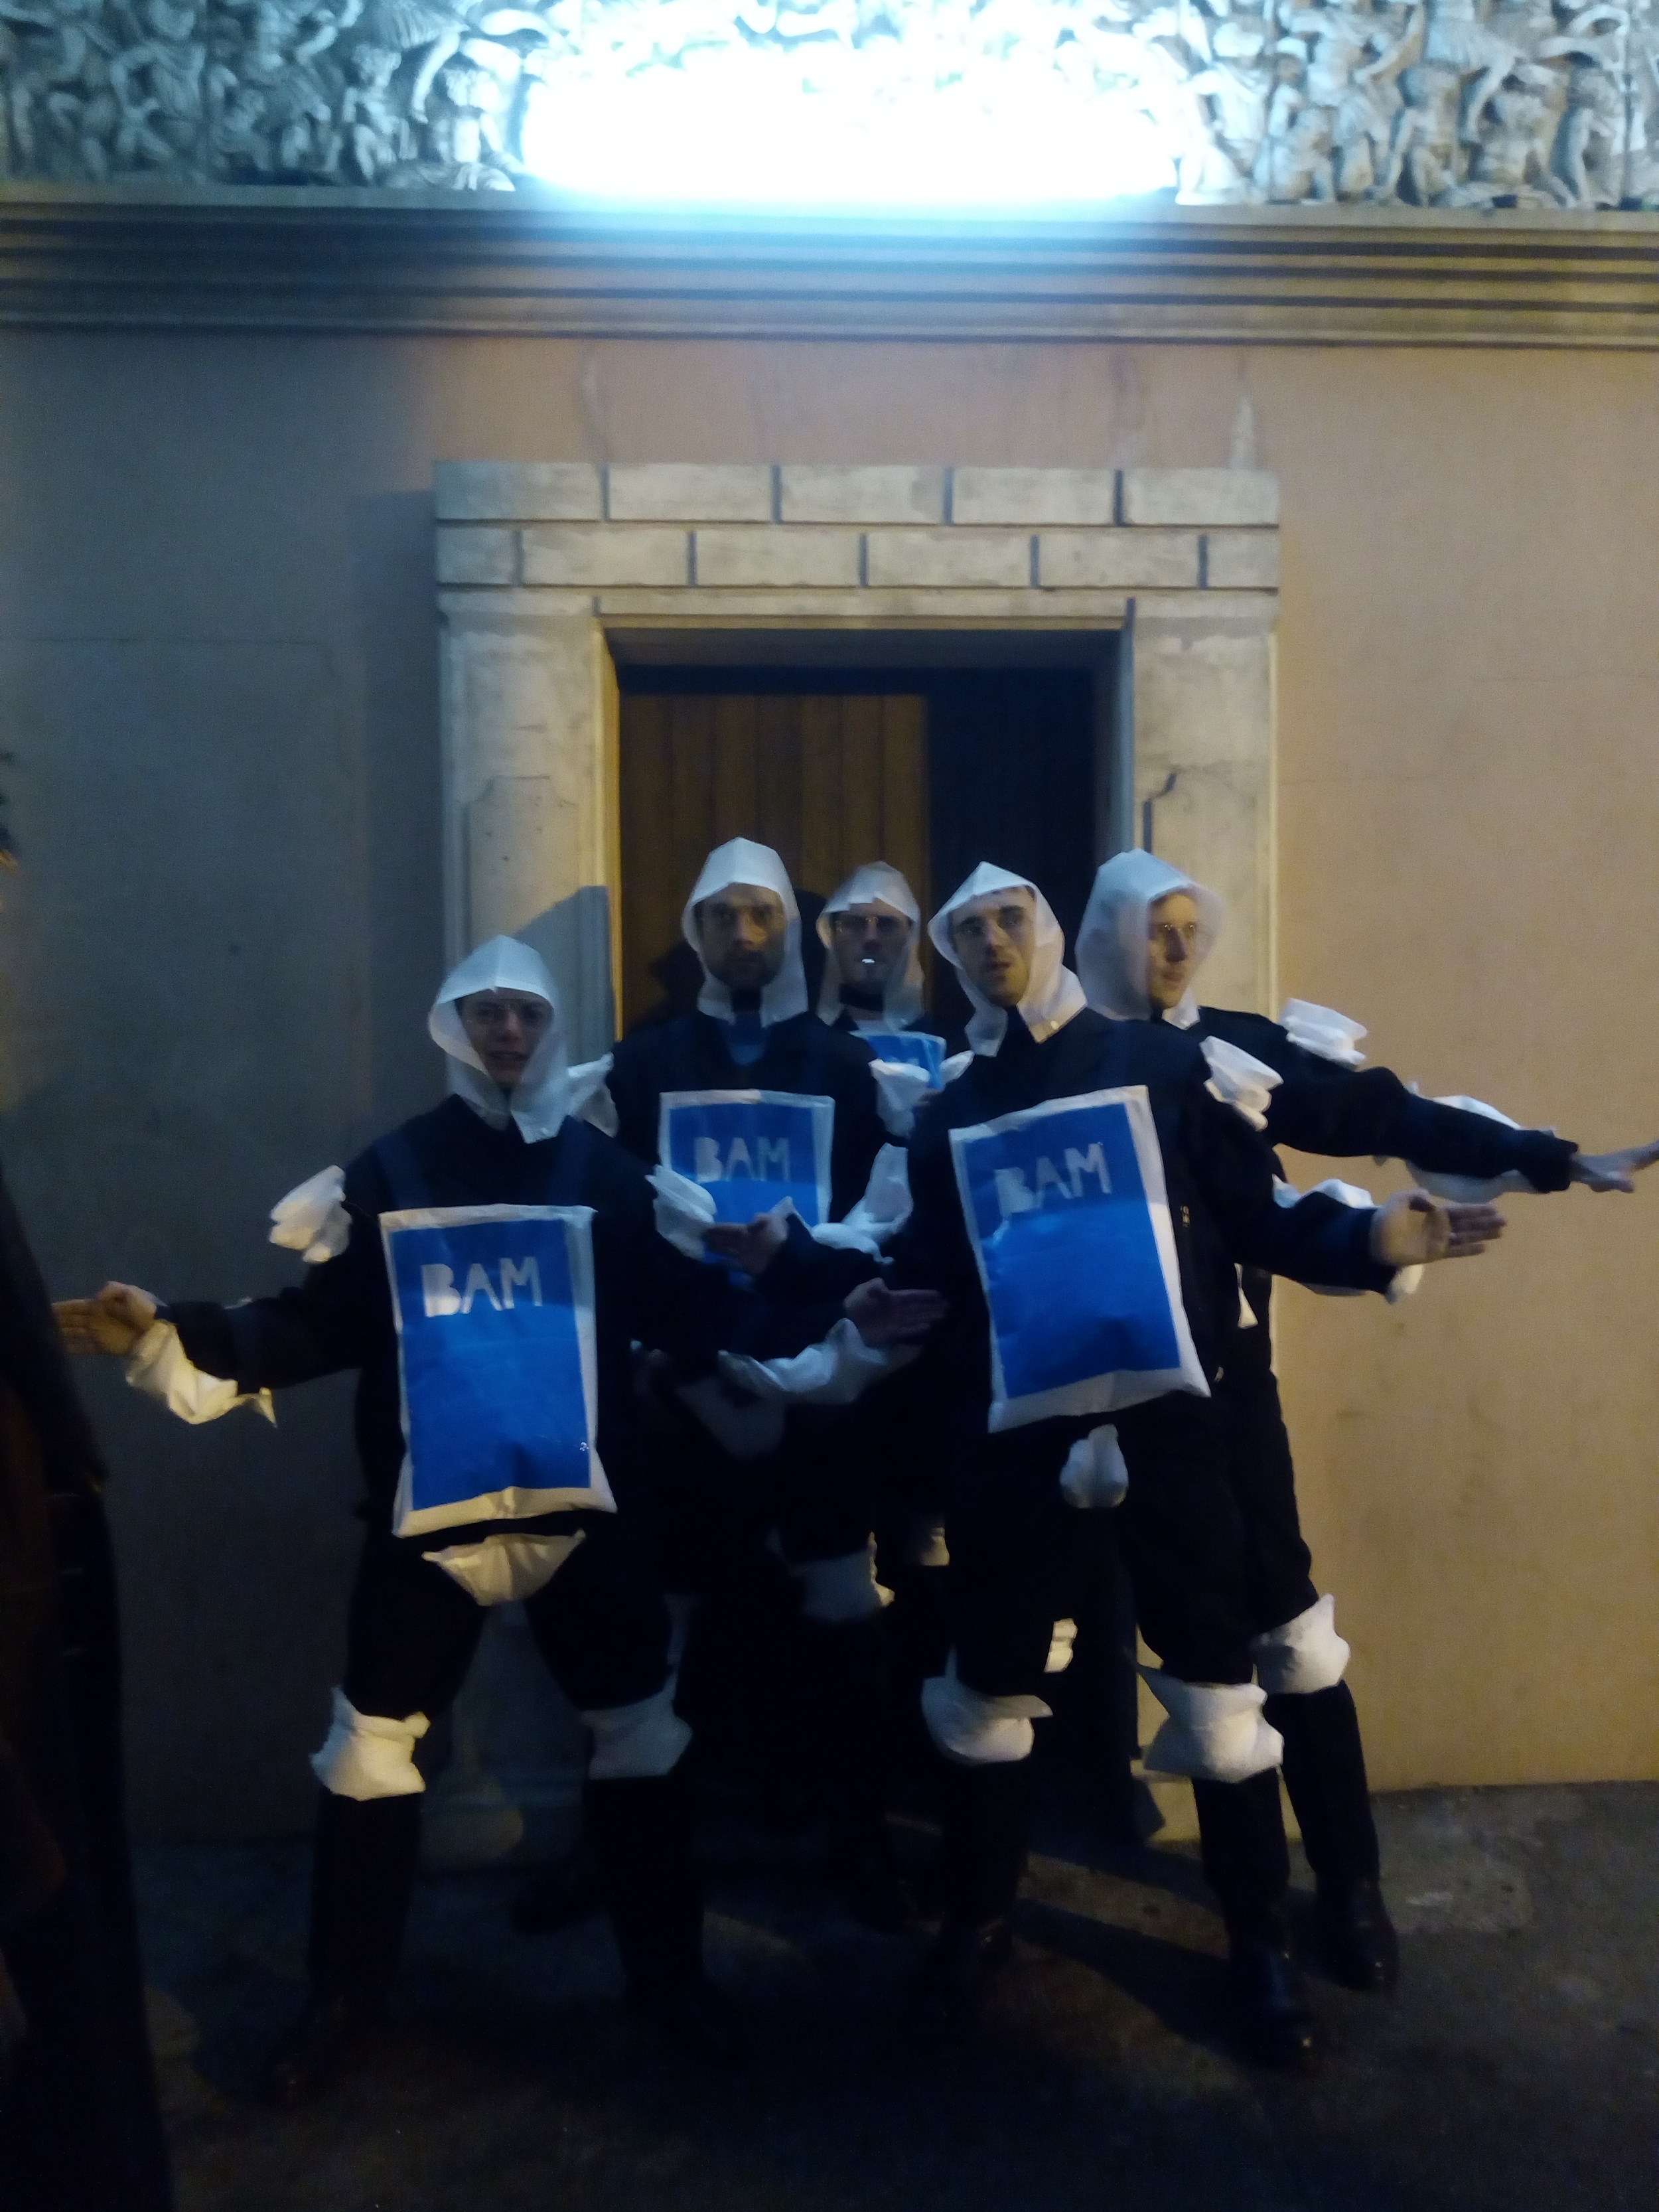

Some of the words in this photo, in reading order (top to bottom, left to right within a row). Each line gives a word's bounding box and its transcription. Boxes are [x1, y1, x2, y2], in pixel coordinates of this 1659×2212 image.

[693, 1136, 792, 1183] BAM
[995, 1142, 1112, 1214] BAM
[421, 1256, 543, 1317] BAM
